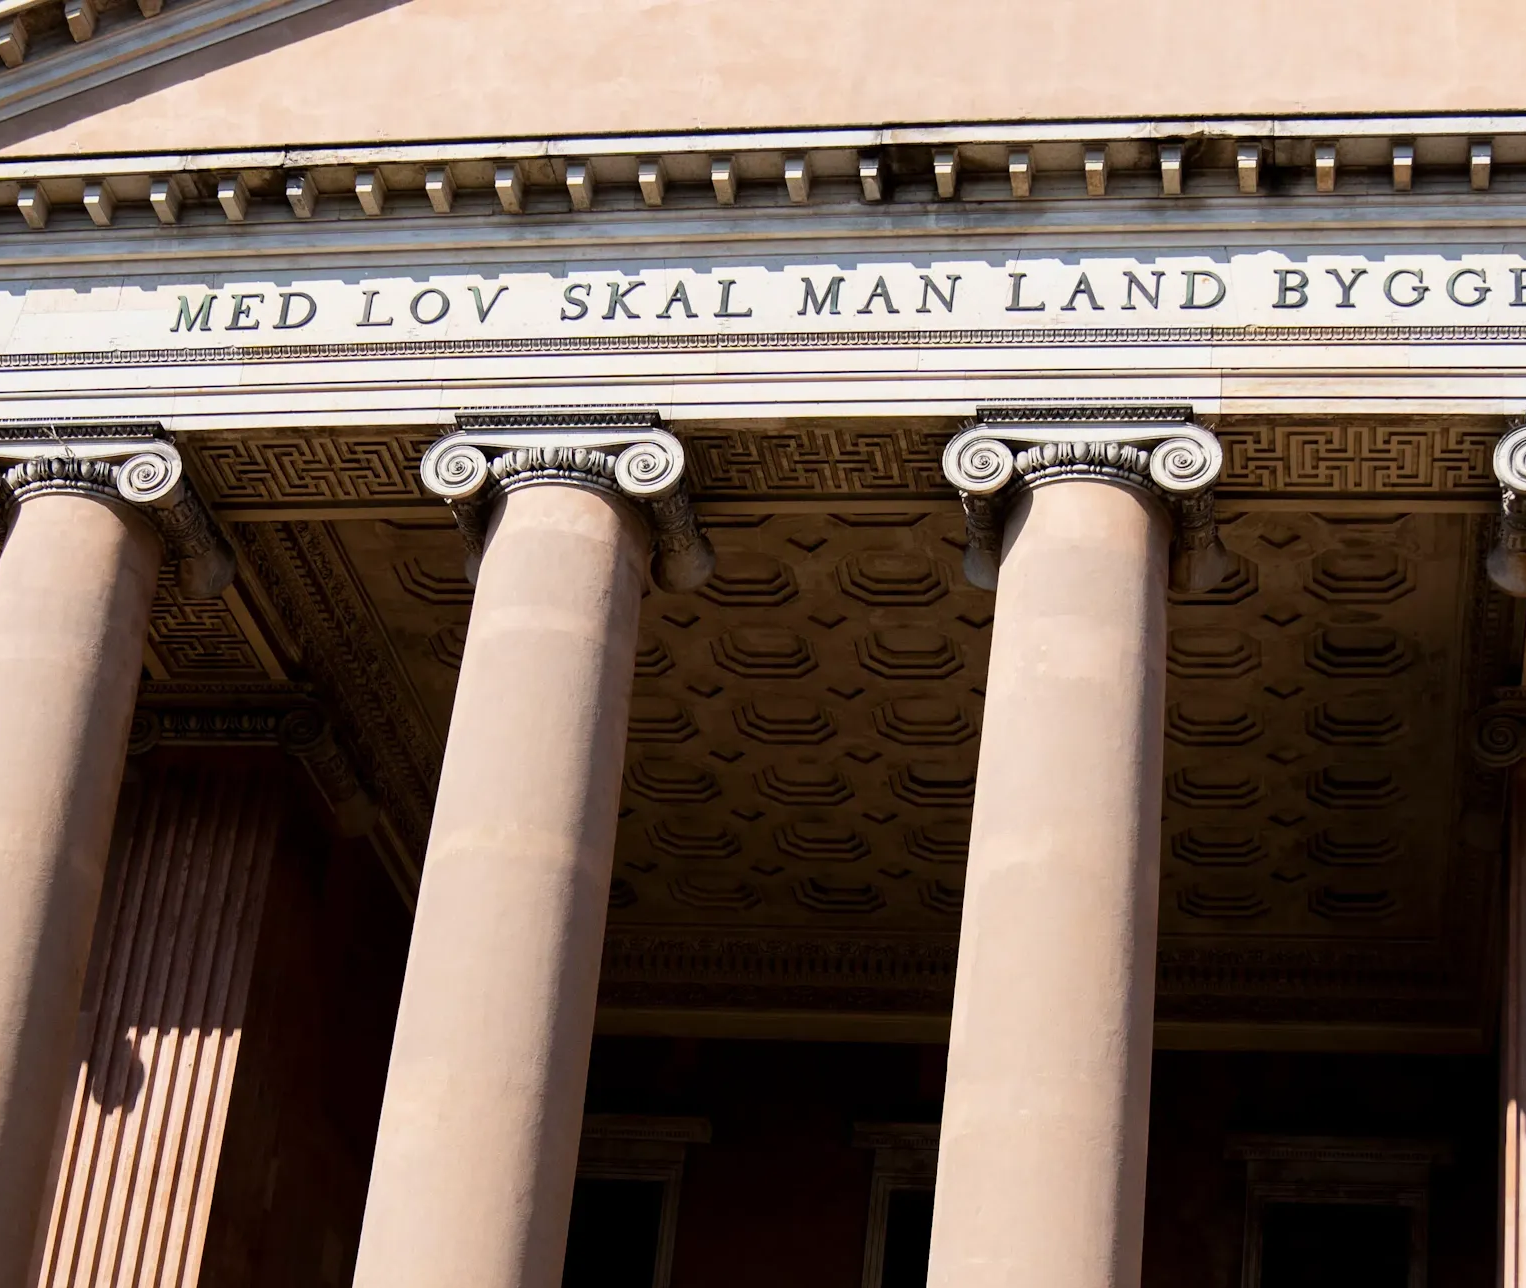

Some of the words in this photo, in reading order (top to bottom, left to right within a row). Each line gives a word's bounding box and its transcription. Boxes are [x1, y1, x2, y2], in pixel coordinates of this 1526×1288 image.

[170, 291, 318, 332] MED
[356, 285, 508, 327] LOV
[560, 279, 753, 322] SKAL
[797, 274, 963, 316] MAN
[1005, 269, 1227, 312] LAND
